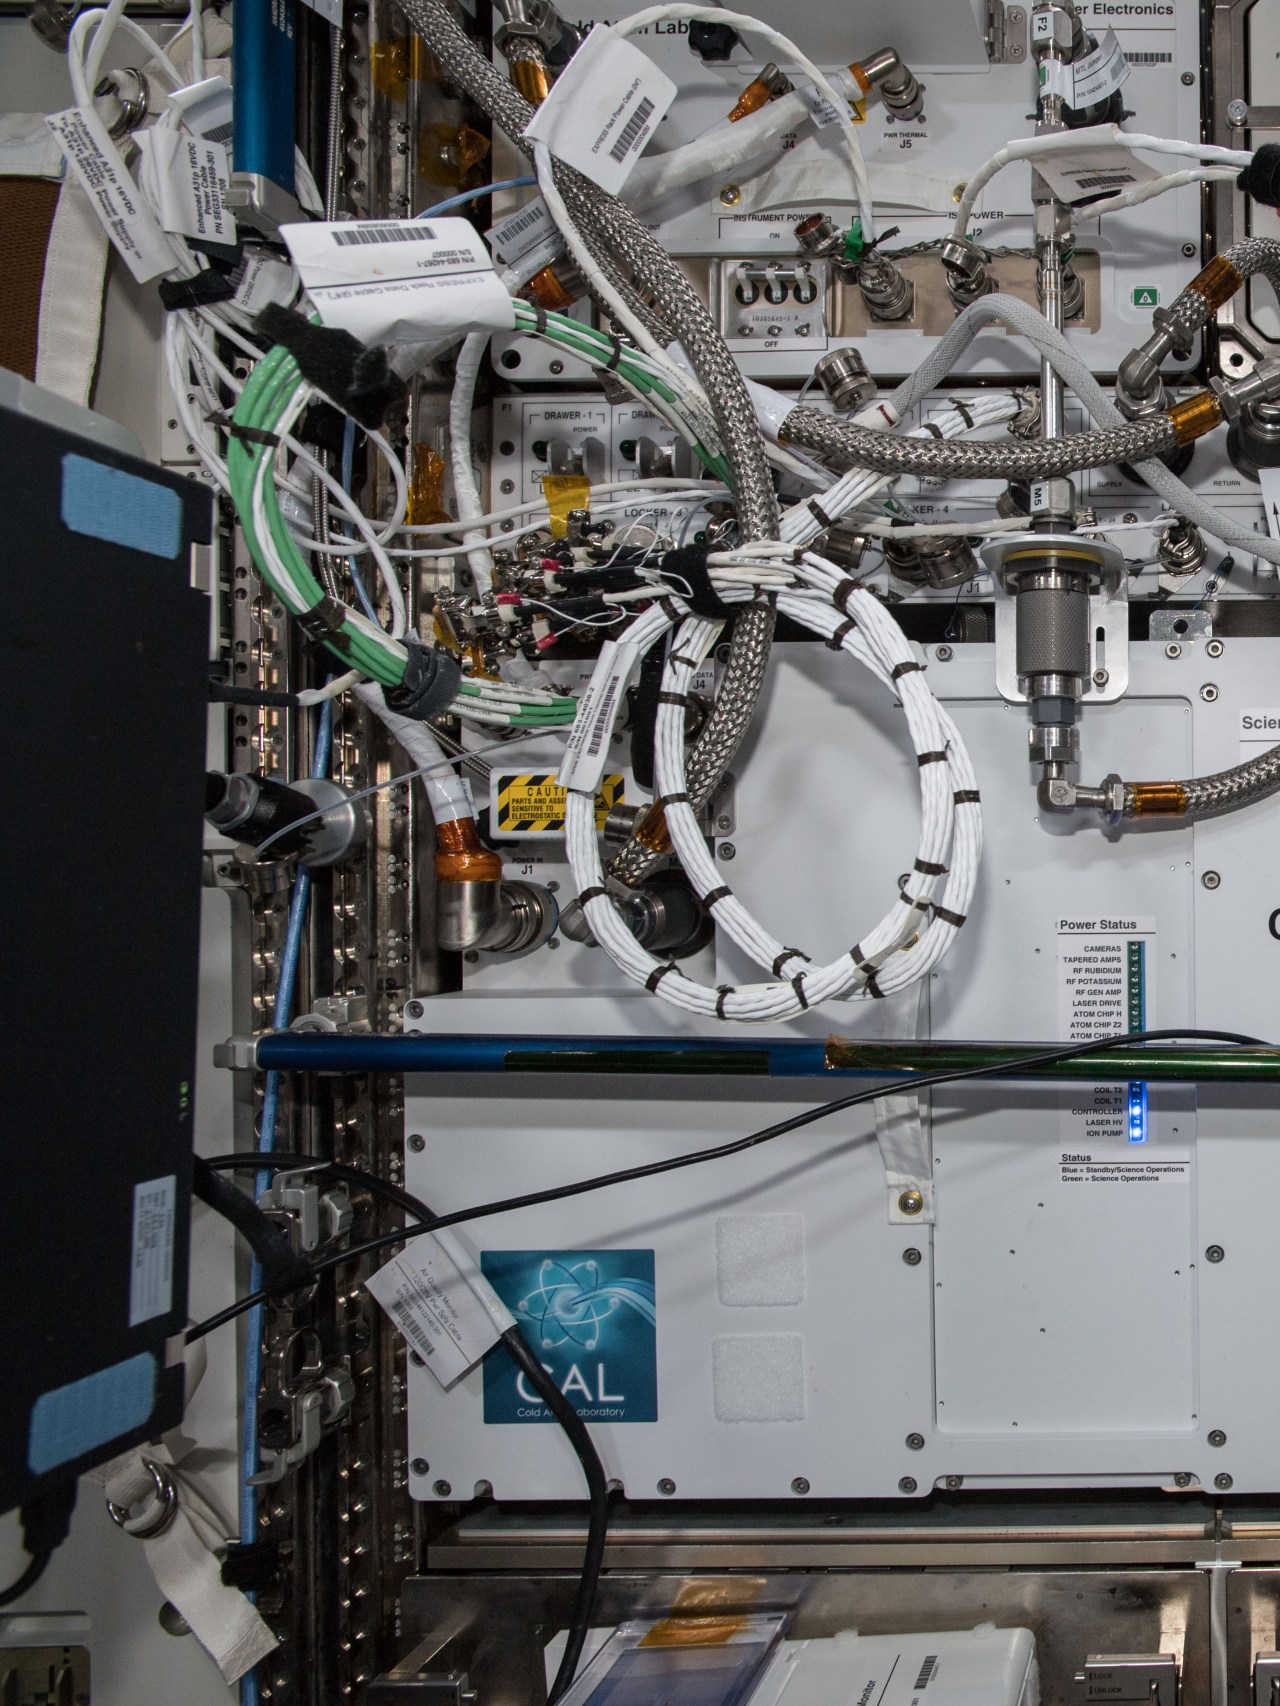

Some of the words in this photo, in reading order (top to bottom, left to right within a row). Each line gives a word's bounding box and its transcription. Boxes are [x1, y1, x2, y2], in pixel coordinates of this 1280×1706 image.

[1093, 3, 1174, 16] Electronics
[1038, 17, 1048, 33] F2
[612, 102, 627, 120] Power
[900, 139, 912, 149] J5
[187, 142, 197, 170] 16VDC
[73, 111, 105, 159] Enhanced
[100, 156, 118, 187] A31p
[115, 184, 136, 217] 16VDC
[192, 170, 202, 193] A31p
[200, 165, 208, 191] Cable
[204, 191, 212, 215] Power
[197, 193, 206, 234] Enhanced
[733, 213, 784, 222] INSTRUMENT
[458, 248, 473, 256] S/N
[461, 256, 475, 265] P/N
[384, 282, 408, 294] Data
[409, 279, 432, 292] Rack
[432, 276, 486, 290] EXPRESS
[353, 285, 384, 298] Cable
[764, 340, 779, 348] OFF
[545, 411, 580, 420] DRAWER
[1034, 487, 1042, 506] M5
[967, 582, 980, 593] J1
[693, 680, 706, 690] J4
[568, 735, 577, 750] P/N
[512, 797, 532, 805] PARTS
[522, 865, 533, 875] J1
[1060, 920, 1096, 930] Power
[1100, 919, 1137, 929] Status
[1083, 945, 1122, 953] CAMERAS
[1061, 1153, 1091, 1162] Status
[1085, 1166, 1144, 1174] Standby/Science
[1146, 1166, 1184, 1174] Operations
[1120, 1175, 1159, 1183] Operations
[420, 1268, 429, 1277] Air
[427, 1275, 443, 1299] Quality
[441, 1296, 459, 1319] Monitor
[430, 1299, 440, 1310] Pwr
[437, 1310, 451, 1324] Sply
[449, 1323, 463, 1342] Cable
[516, 1363, 625, 1403] CAL
[516, 1408, 541, 1417] Cold
